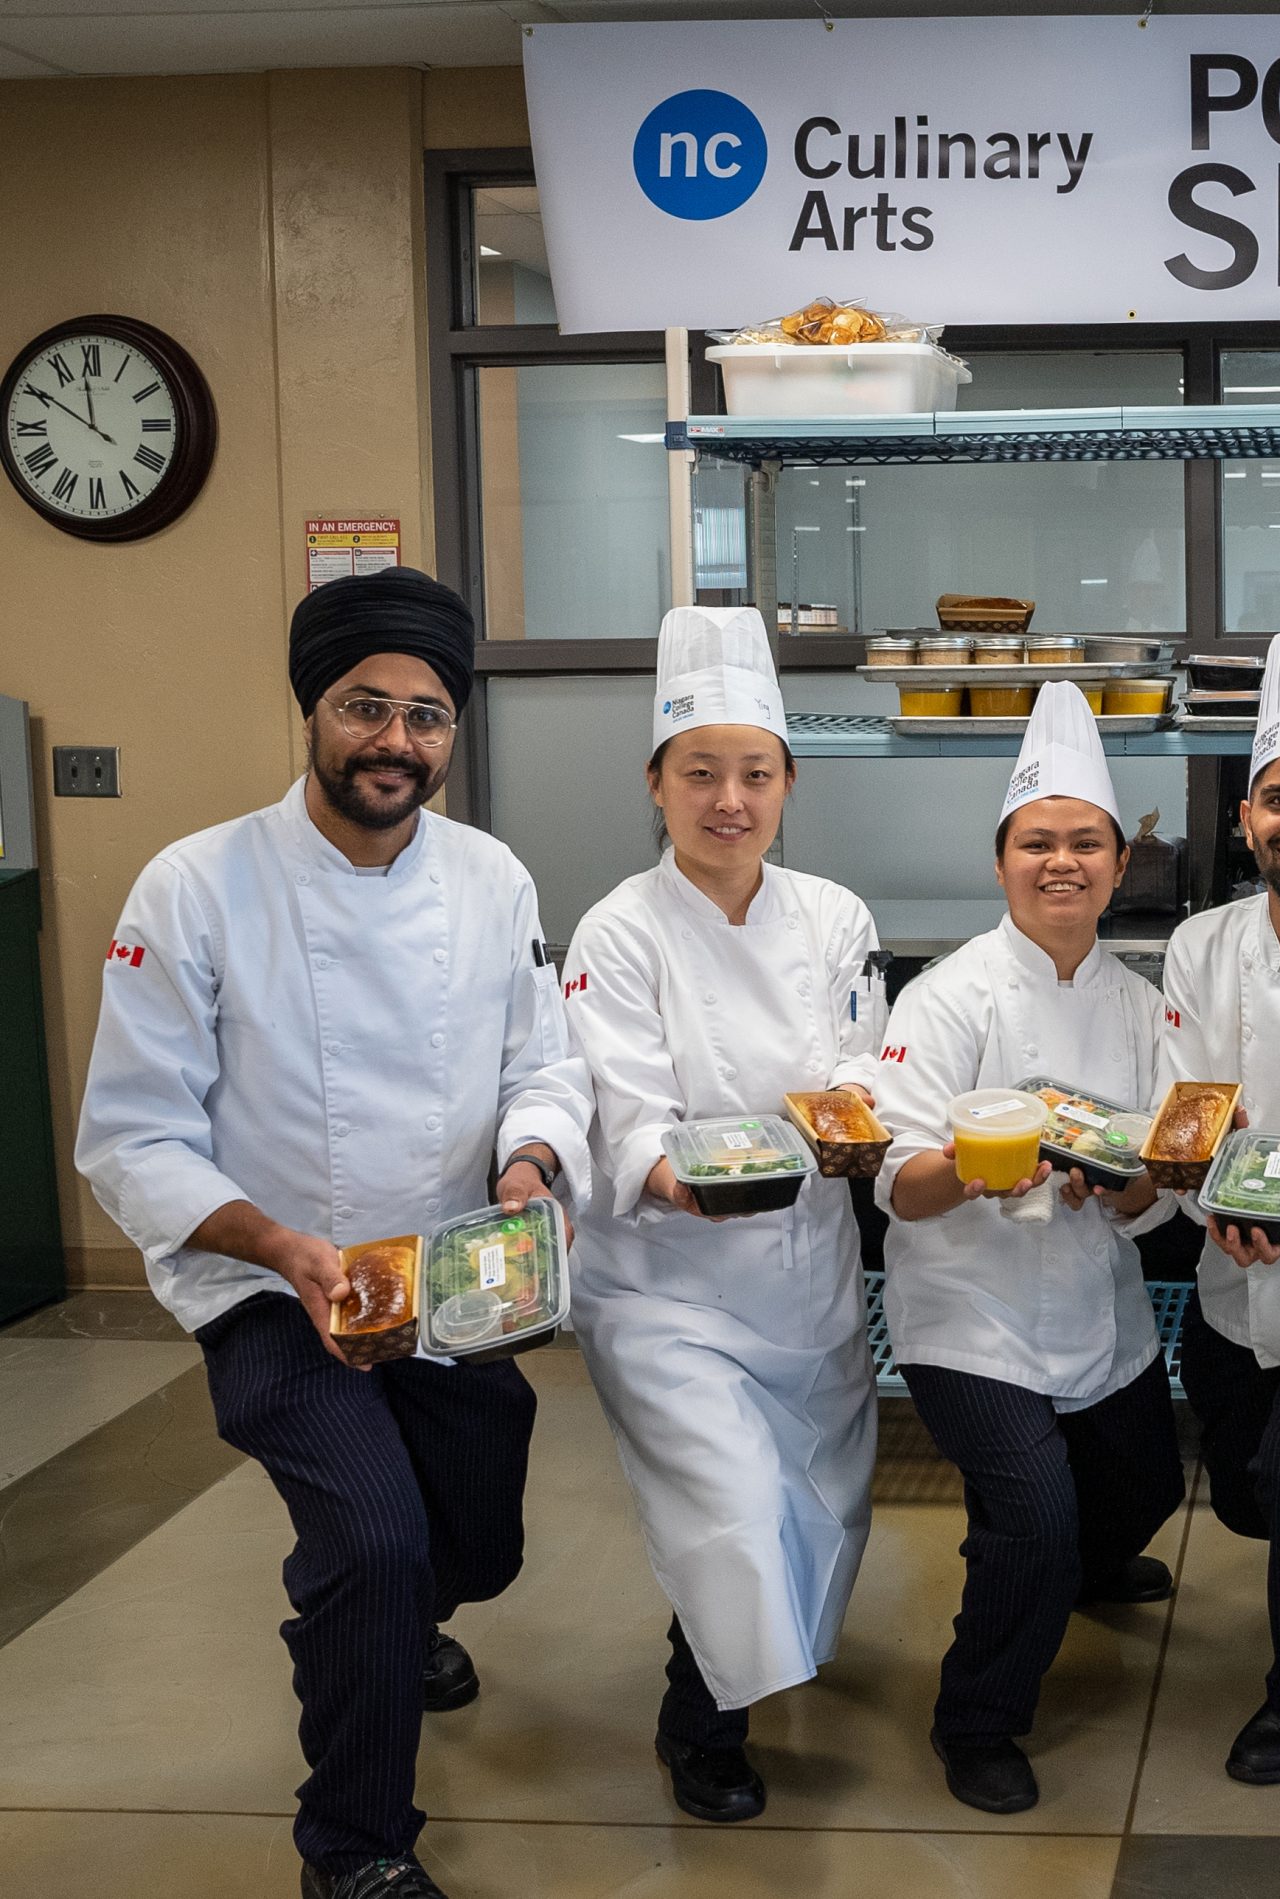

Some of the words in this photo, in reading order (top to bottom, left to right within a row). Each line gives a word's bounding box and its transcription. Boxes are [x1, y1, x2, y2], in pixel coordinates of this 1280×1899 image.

[659, 131, 742, 178] nc
[794, 115, 1093, 194] Culinary
[788, 190, 934, 252] Arts
[309, 522, 319, 532] IN
[322, 522, 335, 532] AN
[338, 522, 396, 532] EMERGENCY:
[672, 694, 694, 705] Niagara
[672, 700, 694, 714] College
[672, 706, 694, 718] Canada
